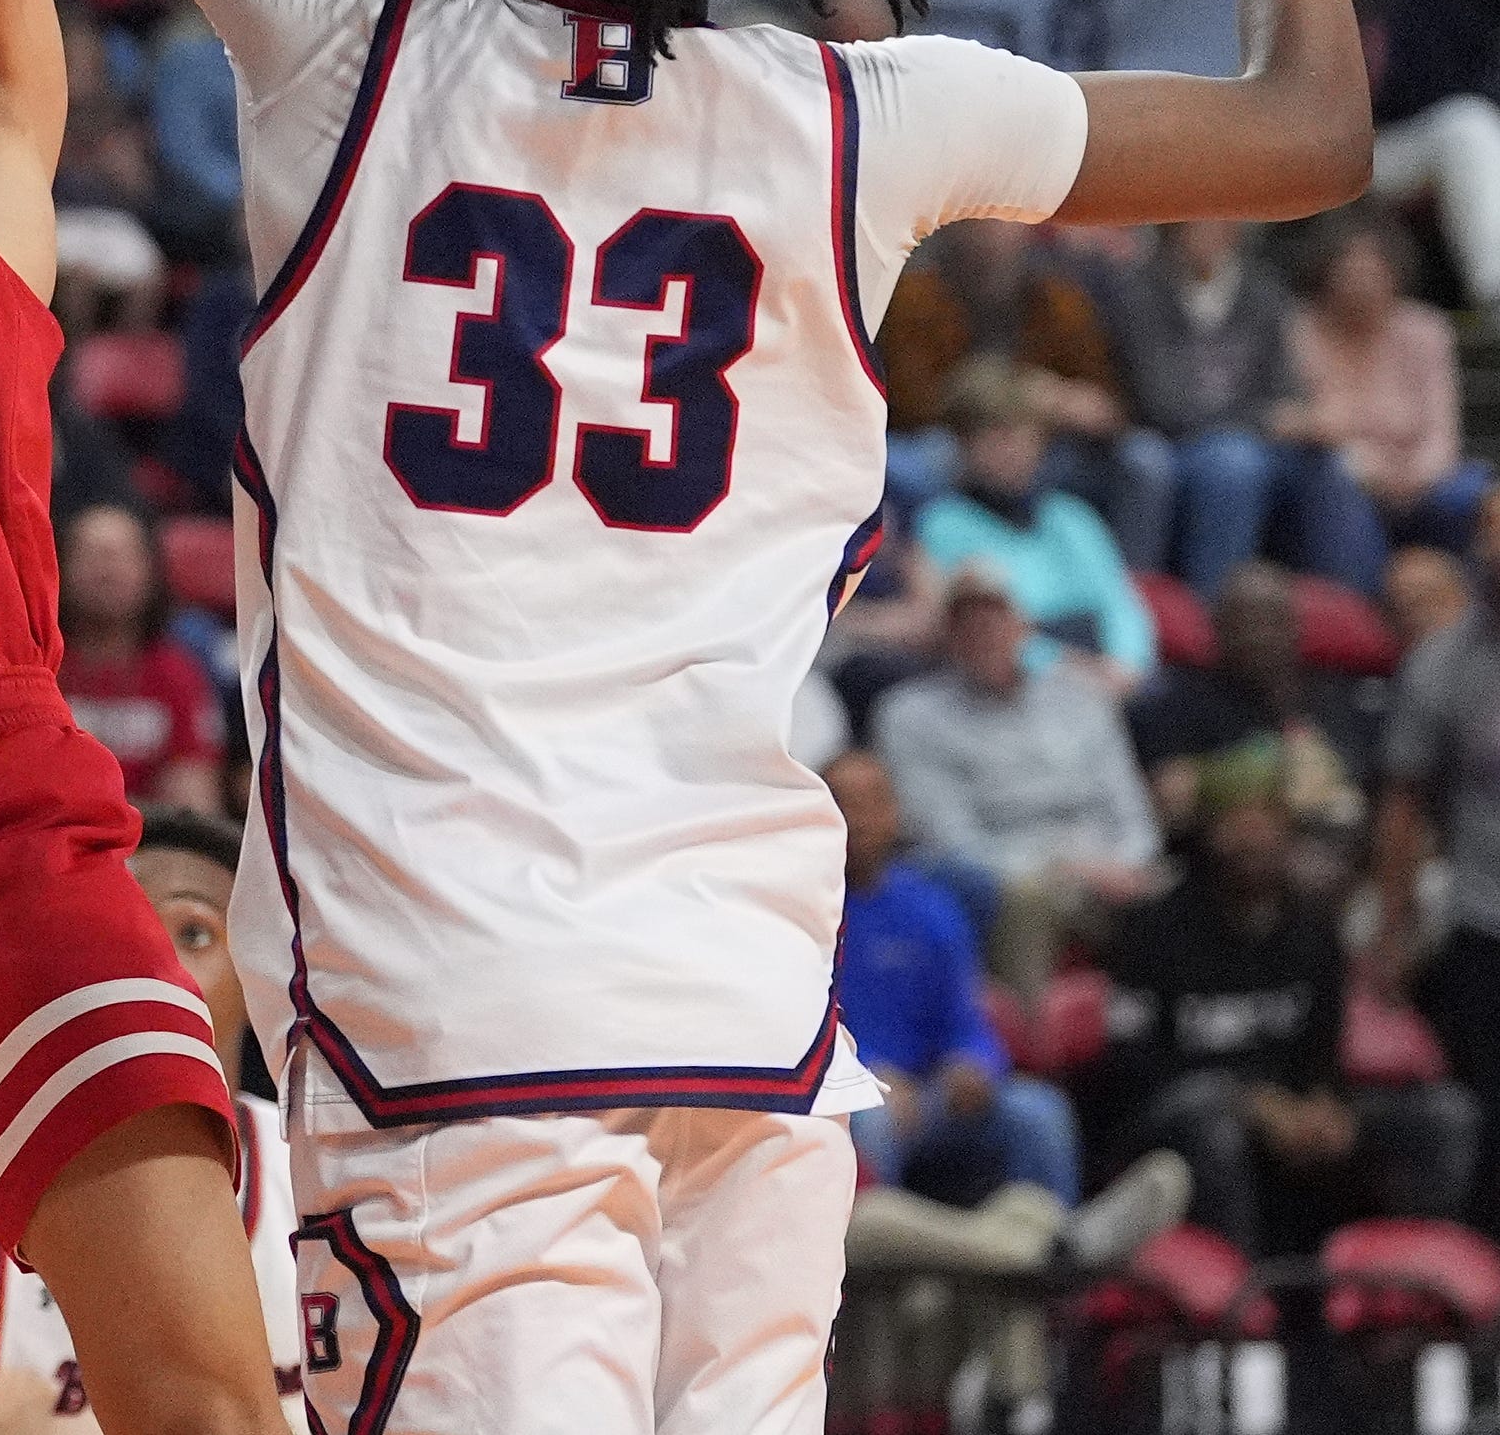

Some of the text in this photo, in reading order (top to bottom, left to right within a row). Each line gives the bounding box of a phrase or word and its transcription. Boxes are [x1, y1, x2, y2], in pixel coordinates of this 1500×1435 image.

[561, 12, 653, 106] B
[383, 181, 764, 534] 33
[301, 1291, 344, 1375] B
